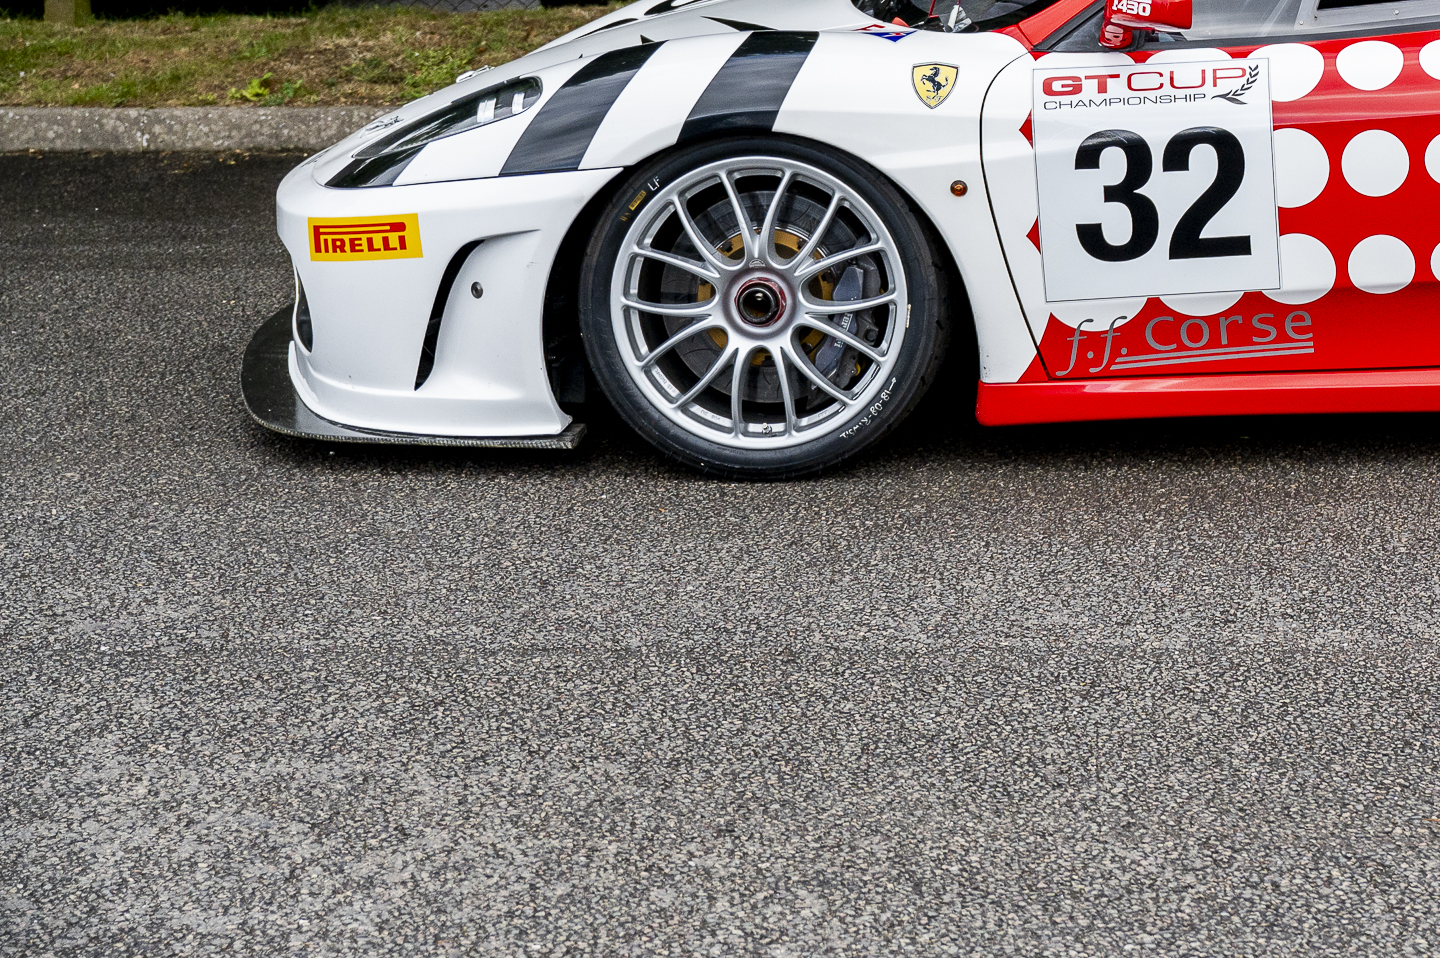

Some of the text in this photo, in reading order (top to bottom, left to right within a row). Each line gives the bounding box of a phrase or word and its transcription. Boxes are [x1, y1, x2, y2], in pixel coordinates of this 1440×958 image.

[1042, 67, 1247, 96] GT CUP
[1043, 93, 1206, 110] CHAMPIONSHIP
[1074, 126, 1252, 262] 32
[313, 222, 407, 253] PIRELLI
[1145, 310, 1313, 351] Corse
